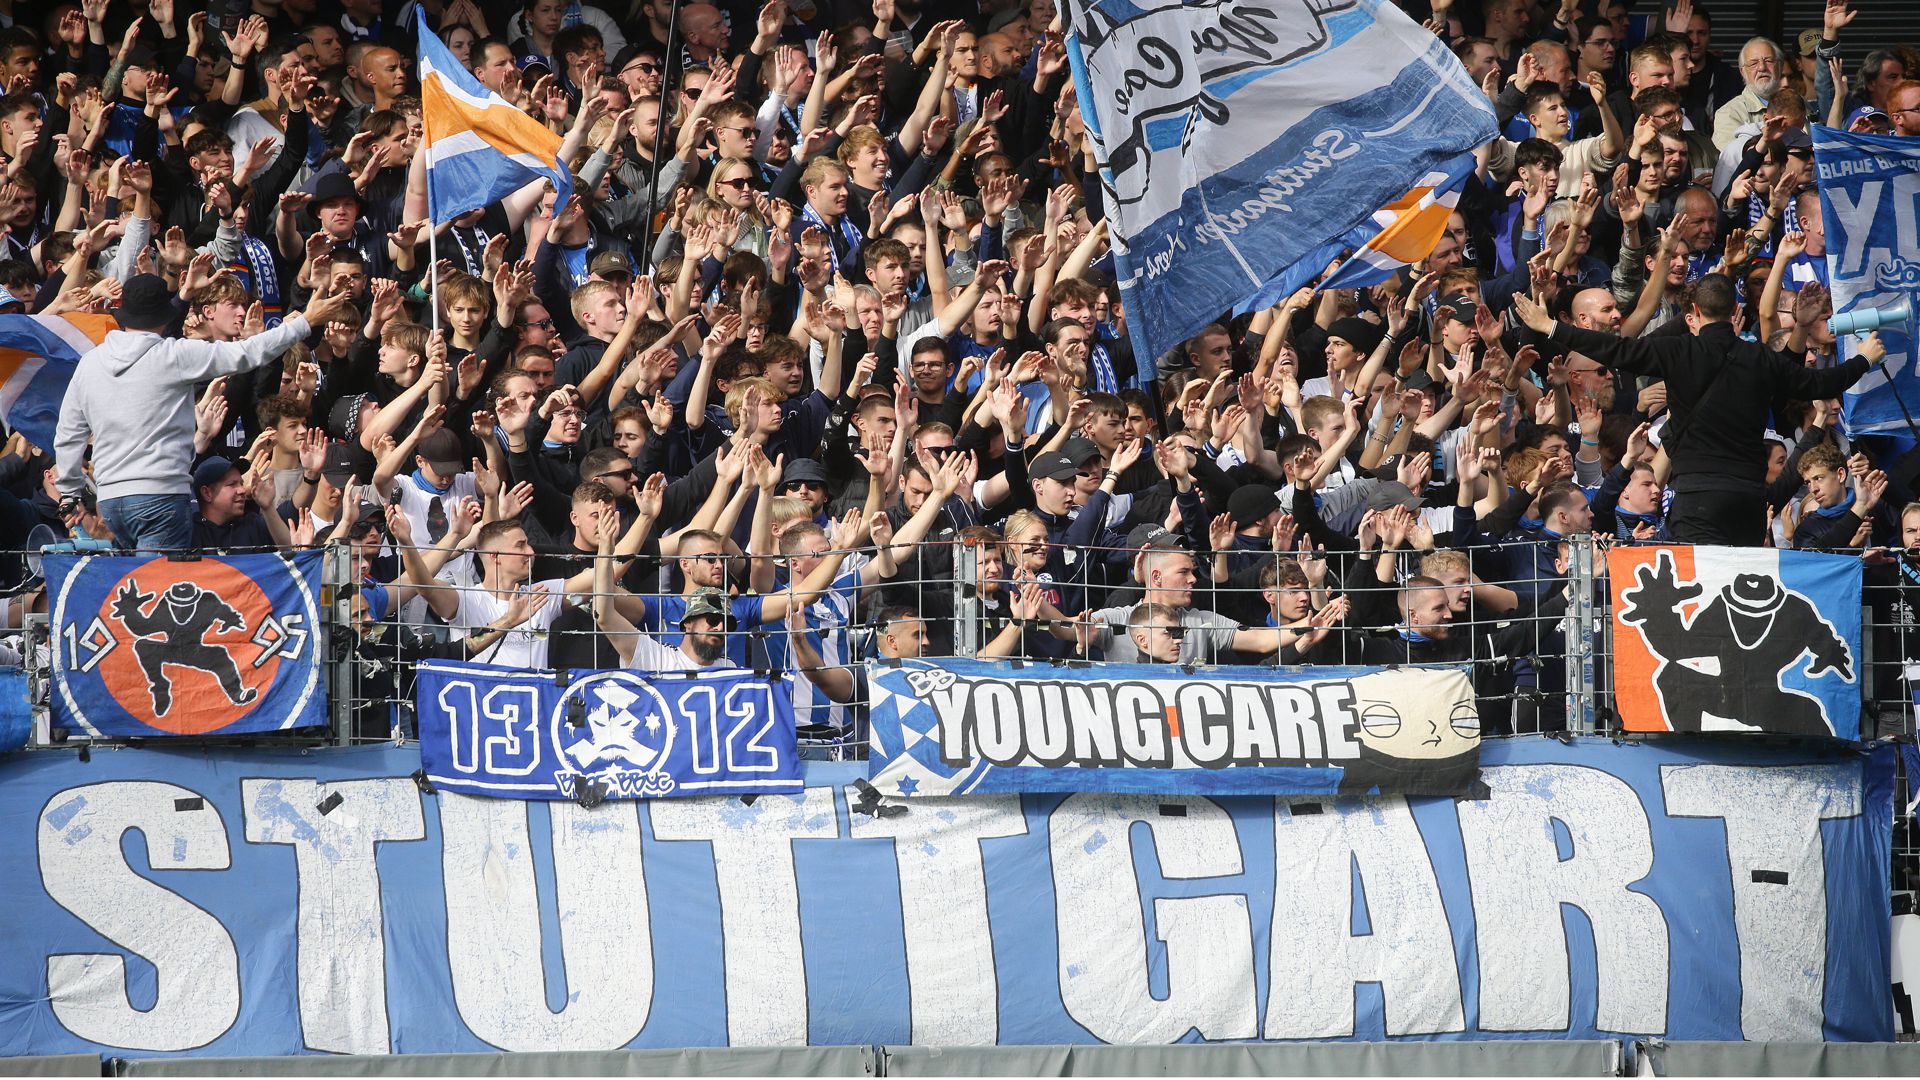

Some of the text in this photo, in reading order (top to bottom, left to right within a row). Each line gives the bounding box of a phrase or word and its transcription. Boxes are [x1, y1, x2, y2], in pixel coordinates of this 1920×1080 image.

[1818, 158, 1875, 180] BLAUE
[64, 614, 308, 673] 19 95
[437, 680, 779, 777] 13 12
[929, 682, 1361, 768] YOUNG CARE
[37, 762, 1864, 1055] STUTTGART
